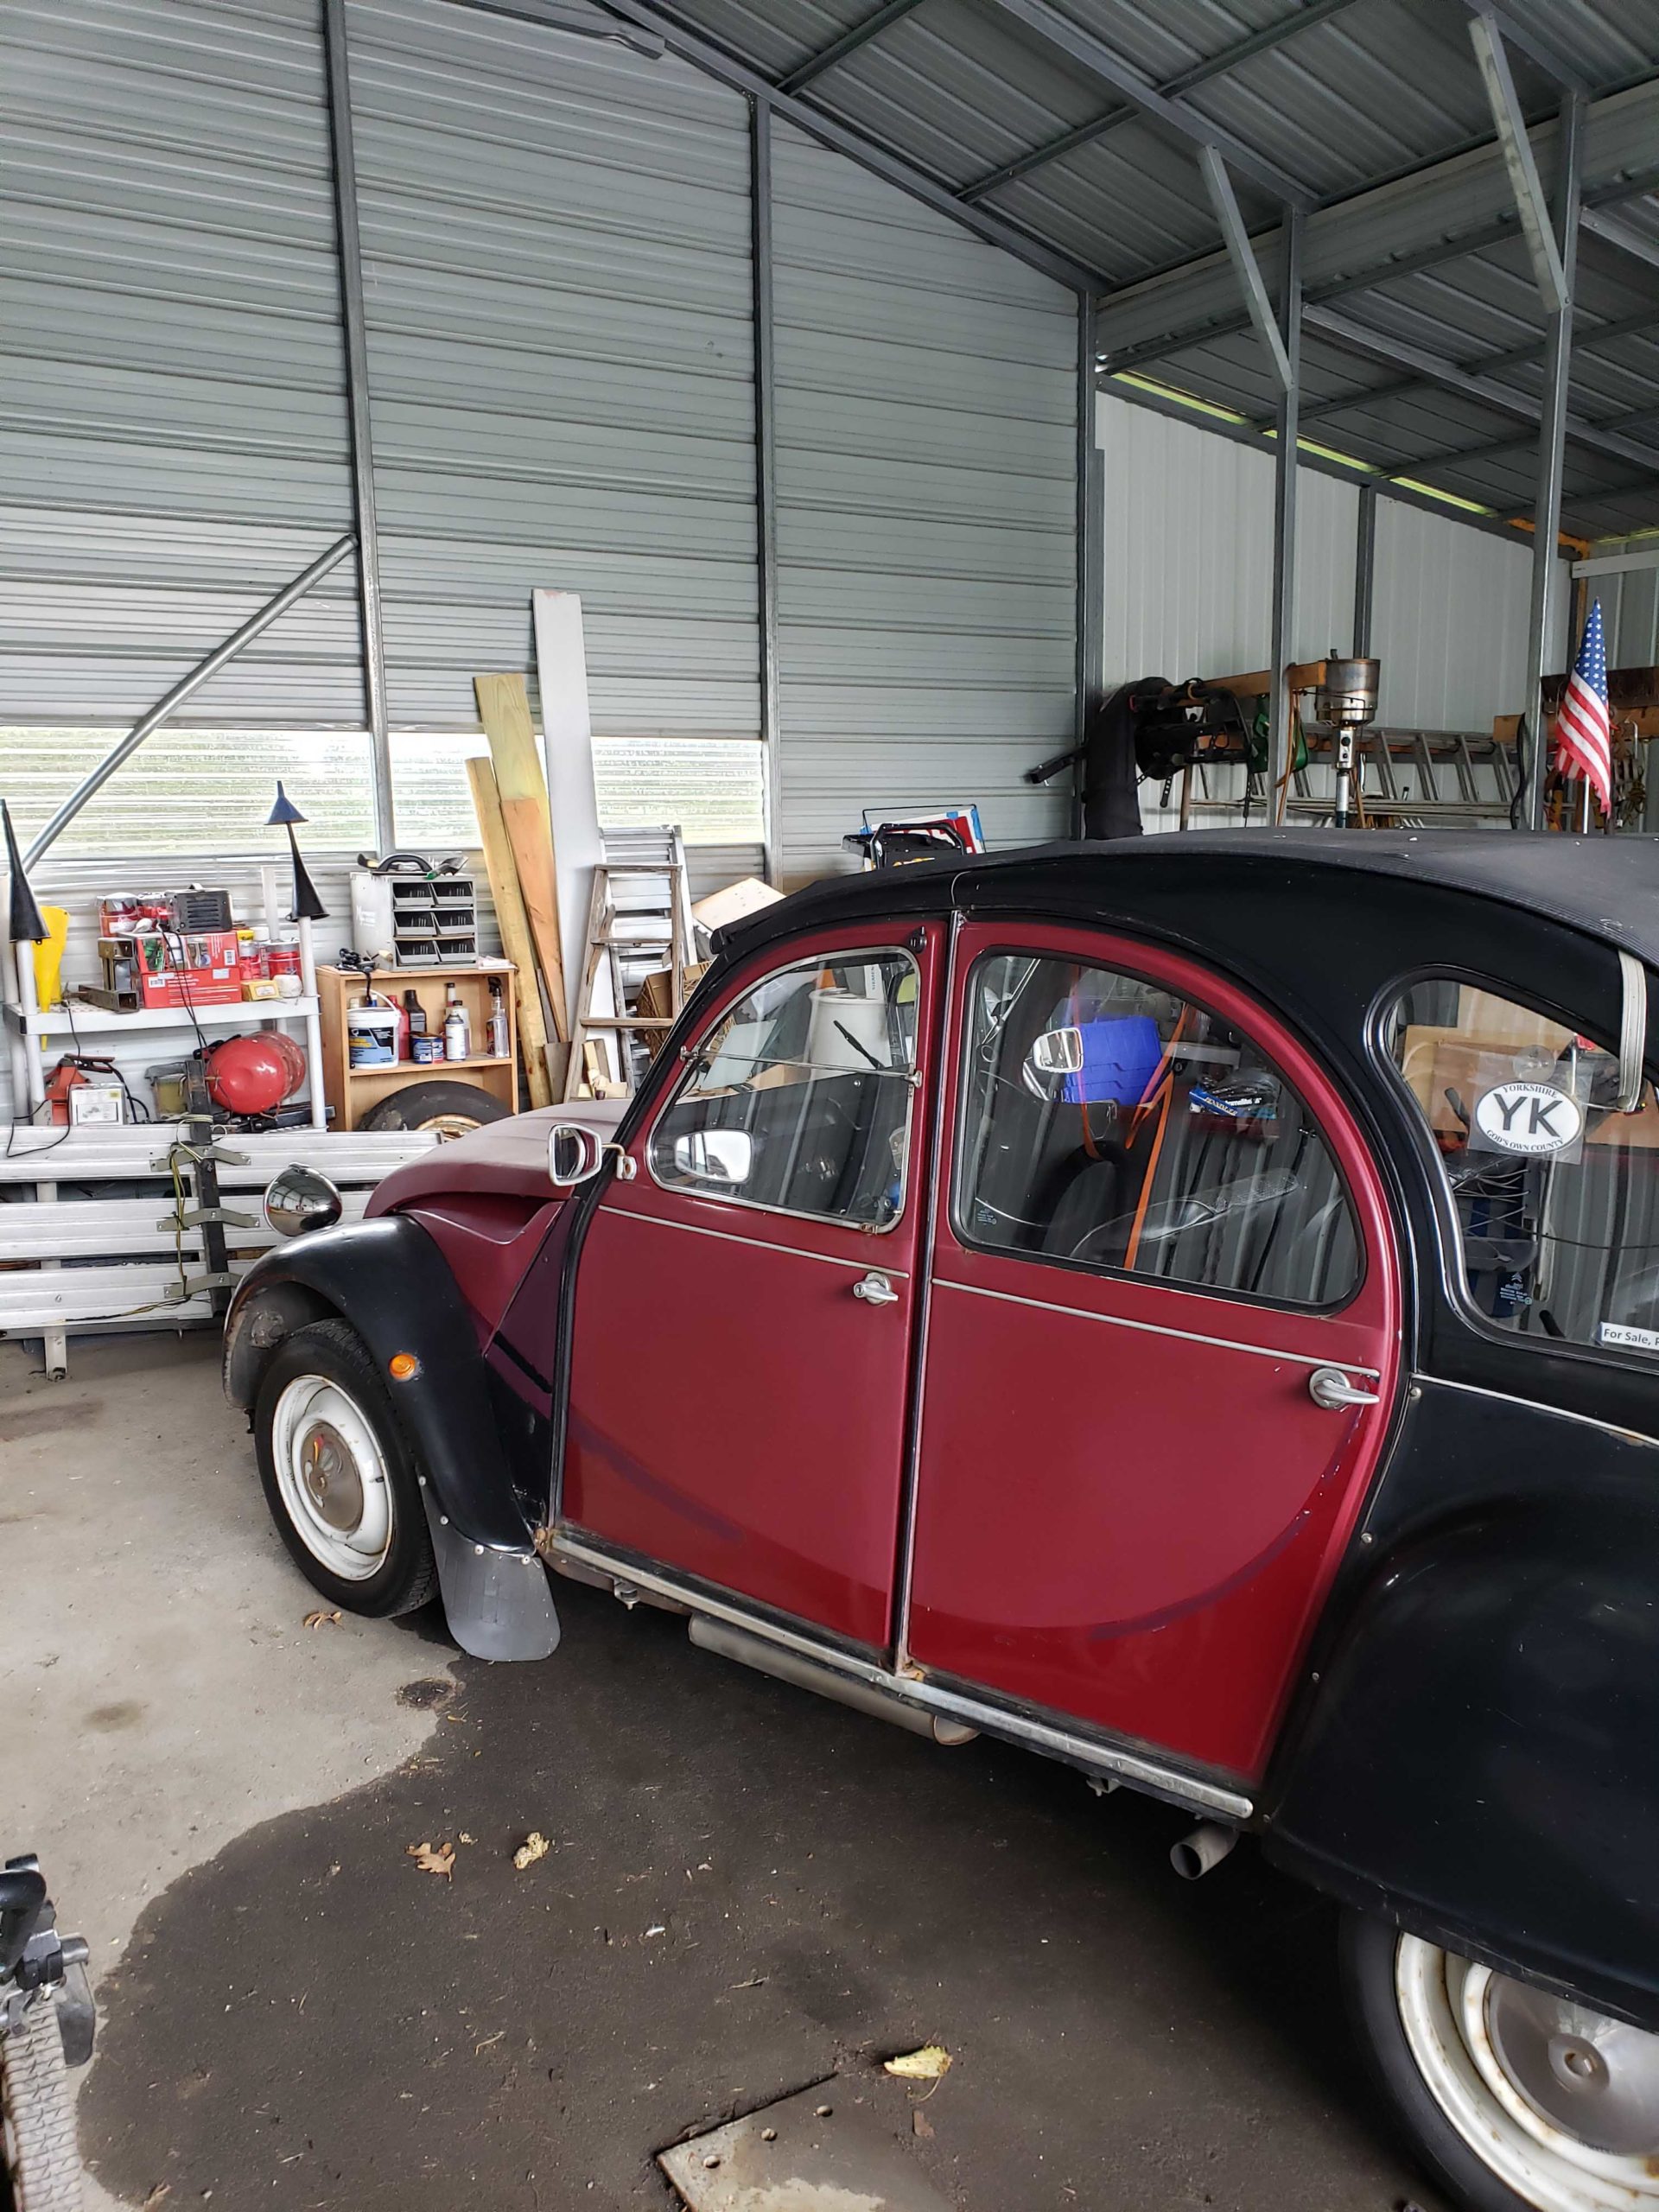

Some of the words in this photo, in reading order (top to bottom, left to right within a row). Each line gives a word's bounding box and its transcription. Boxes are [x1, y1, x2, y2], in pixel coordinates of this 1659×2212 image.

[1503, 1084, 1558, 1099] YORKSHIRE
[1493, 1093, 1563, 1137] YK
[1486, 1129, 1509, 1147] GOD'S
[1510, 1141, 1529, 1152] OWN
[1530, 1138, 1564, 1152] COUNTY
[1604, 1328, 1623, 1339] For
[1624, 1332, 1651, 1345] Sale,
